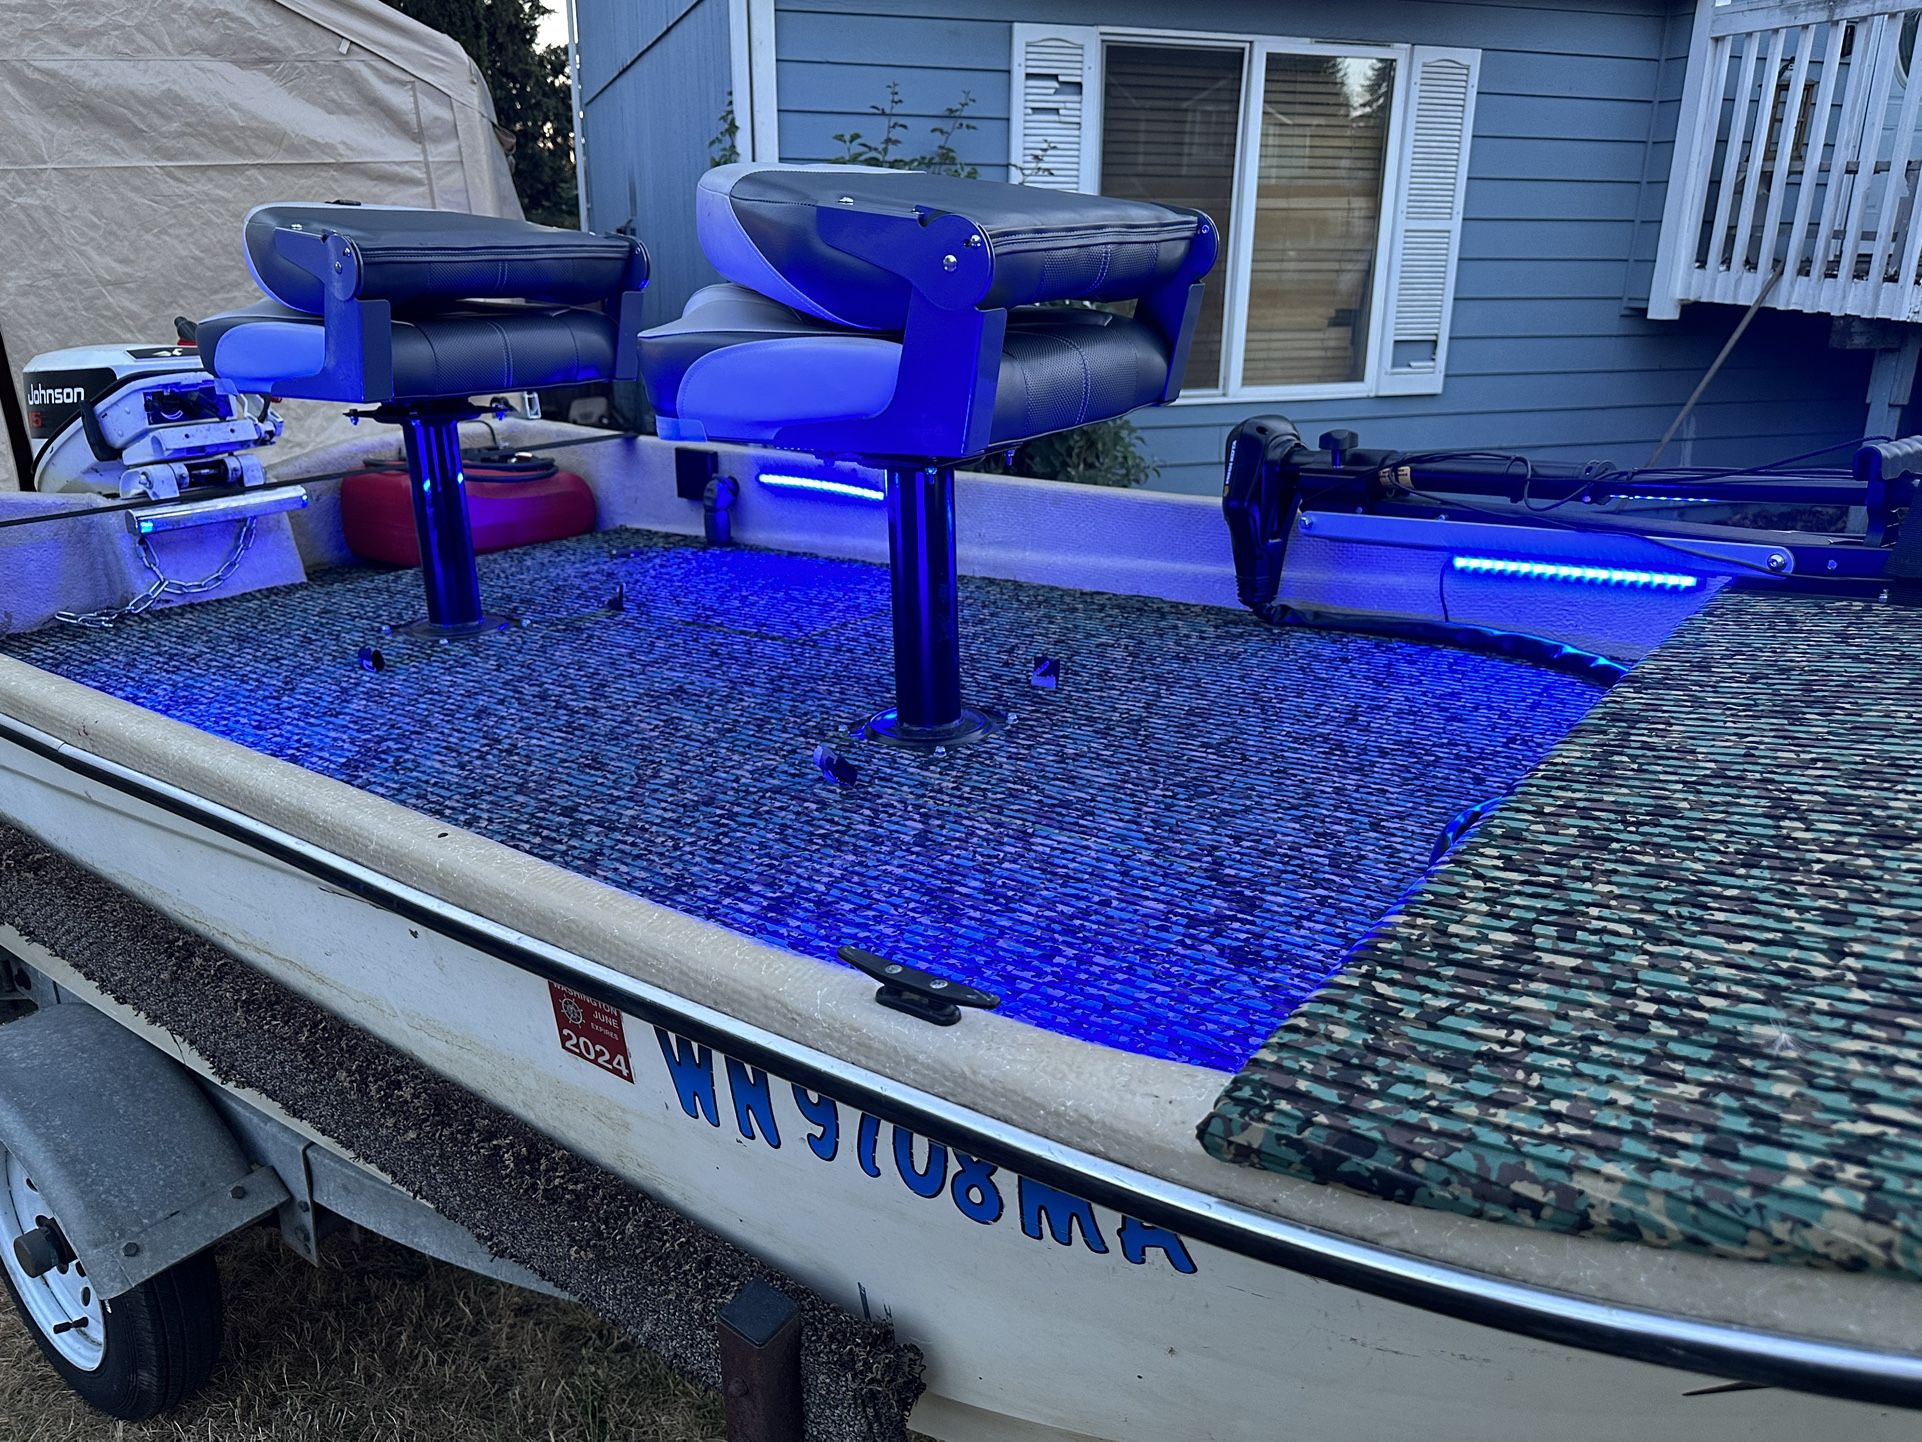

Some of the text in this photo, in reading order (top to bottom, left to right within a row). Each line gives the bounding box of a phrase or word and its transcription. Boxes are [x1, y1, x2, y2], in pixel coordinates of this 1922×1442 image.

[27, 383, 85, 406] Johnson
[591, 1022, 619, 1041] EXPIRES
[593, 1011, 619, 1029] JUNE
[562, 1028, 630, 1077] 2024
[652, 1025, 781, 1149] WN
[1017, 1174, 1198, 1274] MA
